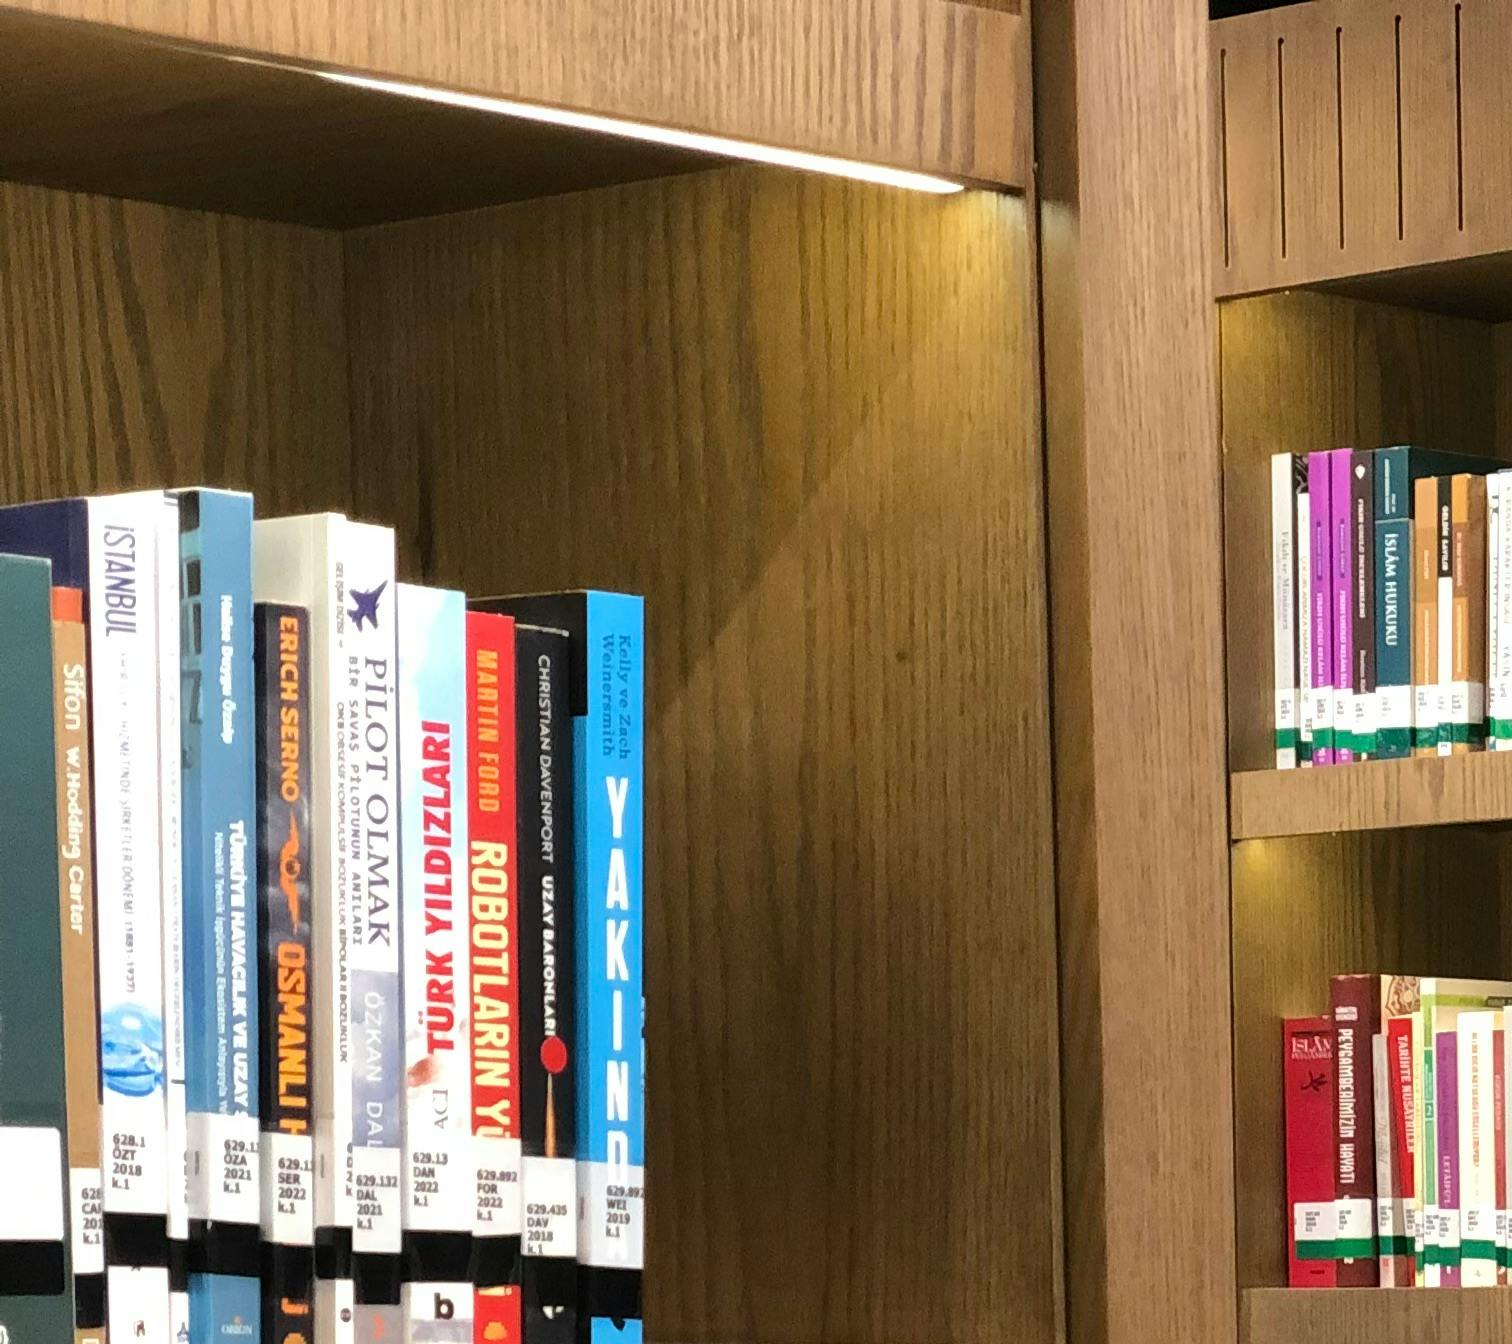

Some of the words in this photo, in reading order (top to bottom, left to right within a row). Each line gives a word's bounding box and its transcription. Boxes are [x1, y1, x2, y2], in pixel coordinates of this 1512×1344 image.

[104, 524, 137, 638] İSTANBUL
[1384, 532, 1400, 577] İSLÂM
[617, 634, 632, 683] Kelly
[1384, 581, 1398, 647] HUKUKU
[63, 663, 86, 729] Sifon
[280, 615, 300, 703] ERICH
[348, 655, 361, 687] BİR
[475, 648, 499, 743] MARTIN
[602, 633, 615, 757] Weinersmith
[364, 655, 394, 781] PİLOT
[536, 653, 553, 759] CHRISTIAN
[618, 713, 632, 760] Zach
[281, 708, 301, 803] SERNO
[477, 753, 500, 813] FORD
[349, 763, 363, 860] PİLOTUNUN
[420, 719, 454, 936] YILDIZLARI
[538, 760, 555, 864] DAVENPORT
[68, 864, 87, 936] Carter
[228, 820, 248, 909] TÜRKİYE
[351, 871, 363, 946] ANILARI
[365, 793, 391, 947] OLMAK
[540, 876, 556, 926] UZAY
[230, 910, 248, 1018] HAVACILIK
[417, 949, 455, 1055] TÜRK
[469, 839, 512, 1089] ROBOTLARIN
[541, 927, 558, 1037] BARONLARI
[277, 941, 309, 1108] OSMANLI
[362, 989, 384, 1083] ÖZKAN
[1397, 1034, 1412, 1083] TARİHTE
[232, 1052, 249, 1105] UZAY
[1337, 1028, 1356, 1138] PEYGAMBERİMİZİN
[112, 1133, 146, 1149] 628.1
[112, 1163, 142, 1177] 2018
[278, 1171, 301, 1185] SER
[1339, 1143, 1355, 1185] HAYATI
